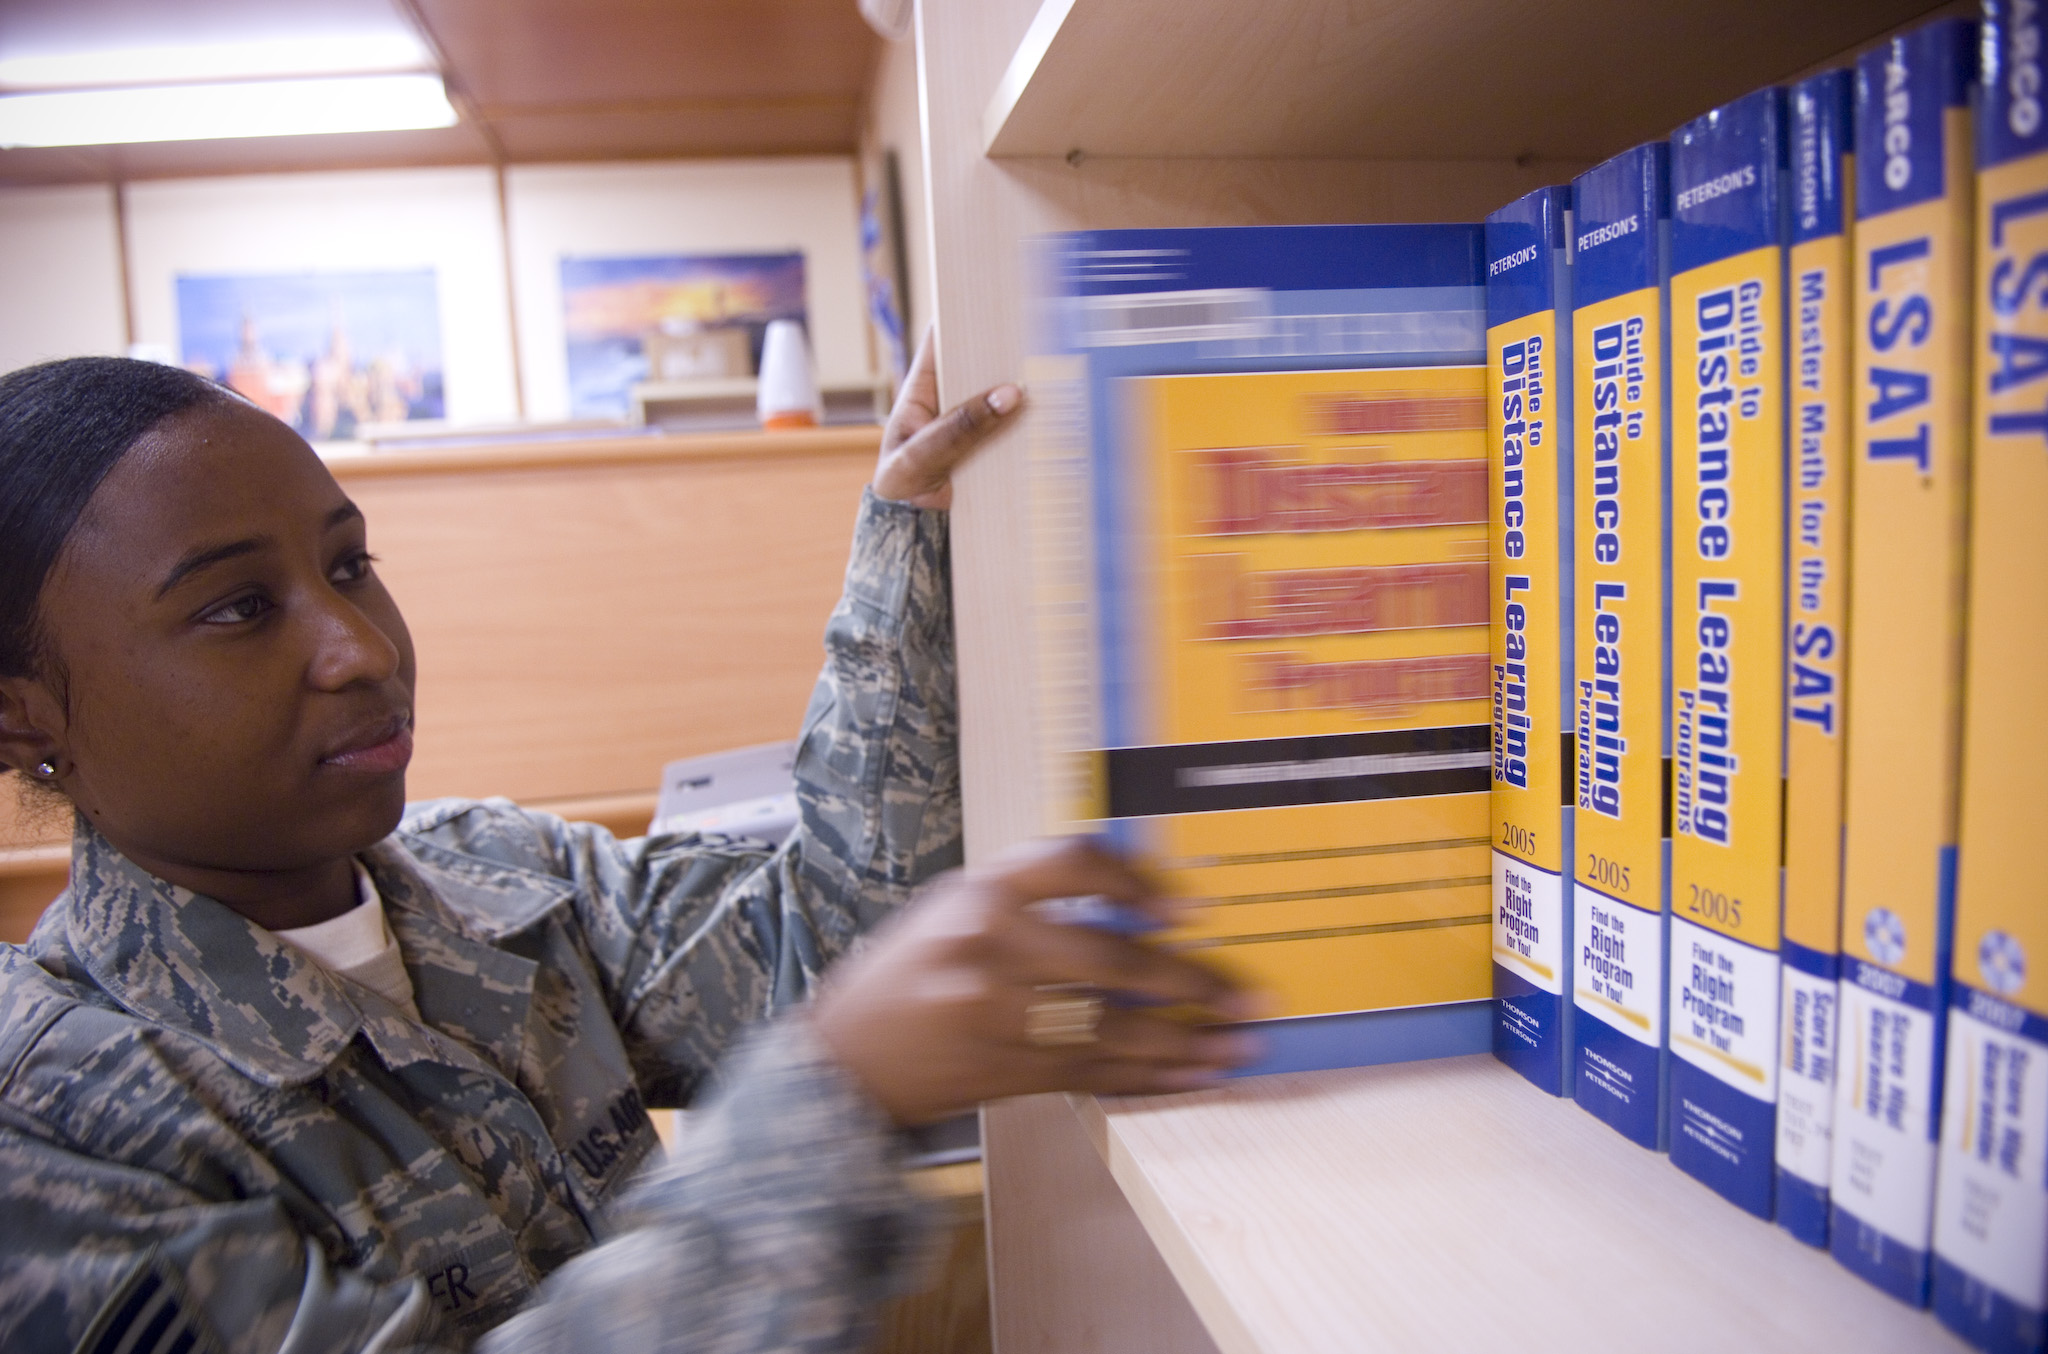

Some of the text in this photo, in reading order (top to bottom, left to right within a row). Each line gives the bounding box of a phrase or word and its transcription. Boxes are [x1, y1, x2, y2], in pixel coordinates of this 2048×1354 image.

[1884, 61, 1911, 191] ARCO
[1677, 166, 1756, 212] PETERSON'S
[1578, 215, 1638, 252] PETERSON'S
[1490, 245, 1537, 277] PETERSON'S
[1989, 190, 2048, 450] LSAT
[1739, 280, 1763, 419] Guide to
[1868, 236, 1932, 471] LSAT
[1528, 336, 1543, 446] Guide to
[1626, 317, 1643, 439] Guide to
[1792, 270, 1835, 734] Master Math for the SAT
[1503, 341, 1530, 788] Distance Learning
[1592, 323, 1626, 819] Distance Learning
[1696, 288, 1738, 847] Distance Learning
[1494, 665, 1504, 782] Programs
[1579, 680, 1593, 809] Programs
[1678, 690, 1695, 834] Programs
[1502, 822, 1535, 855] 2005
[1506, 869, 1531, 894] Find the
[1588, 853, 1630, 893] 2005
[1506, 886, 1532, 920] Right
[1591, 905, 1624, 934] Find the
[1688, 884, 1742, 929] 2005
[1500, 905, 1539, 944] Program
[1506, 932, 1531, 958] for You!
[1591, 924, 1625, 963] Right
[1583, 945, 1633, 990] Program
[1692, 942, 1733, 974] Find the
[1592, 975, 1623, 1005] for You!
[1692, 964, 1734, 1007] Right
[1501, 998, 1539, 1028] THOMSON
[1683, 986, 1744, 1037] Program
[1502, 1020, 1537, 1048] PETERSON'S
[1692, 1020, 1731, 1053] for You!
[1584, 1047, 1632, 1082] THOMSON
[1585, 1070, 1630, 1104] PETERSON'S
[1683, 1099, 1743, 1141] THOMSON
